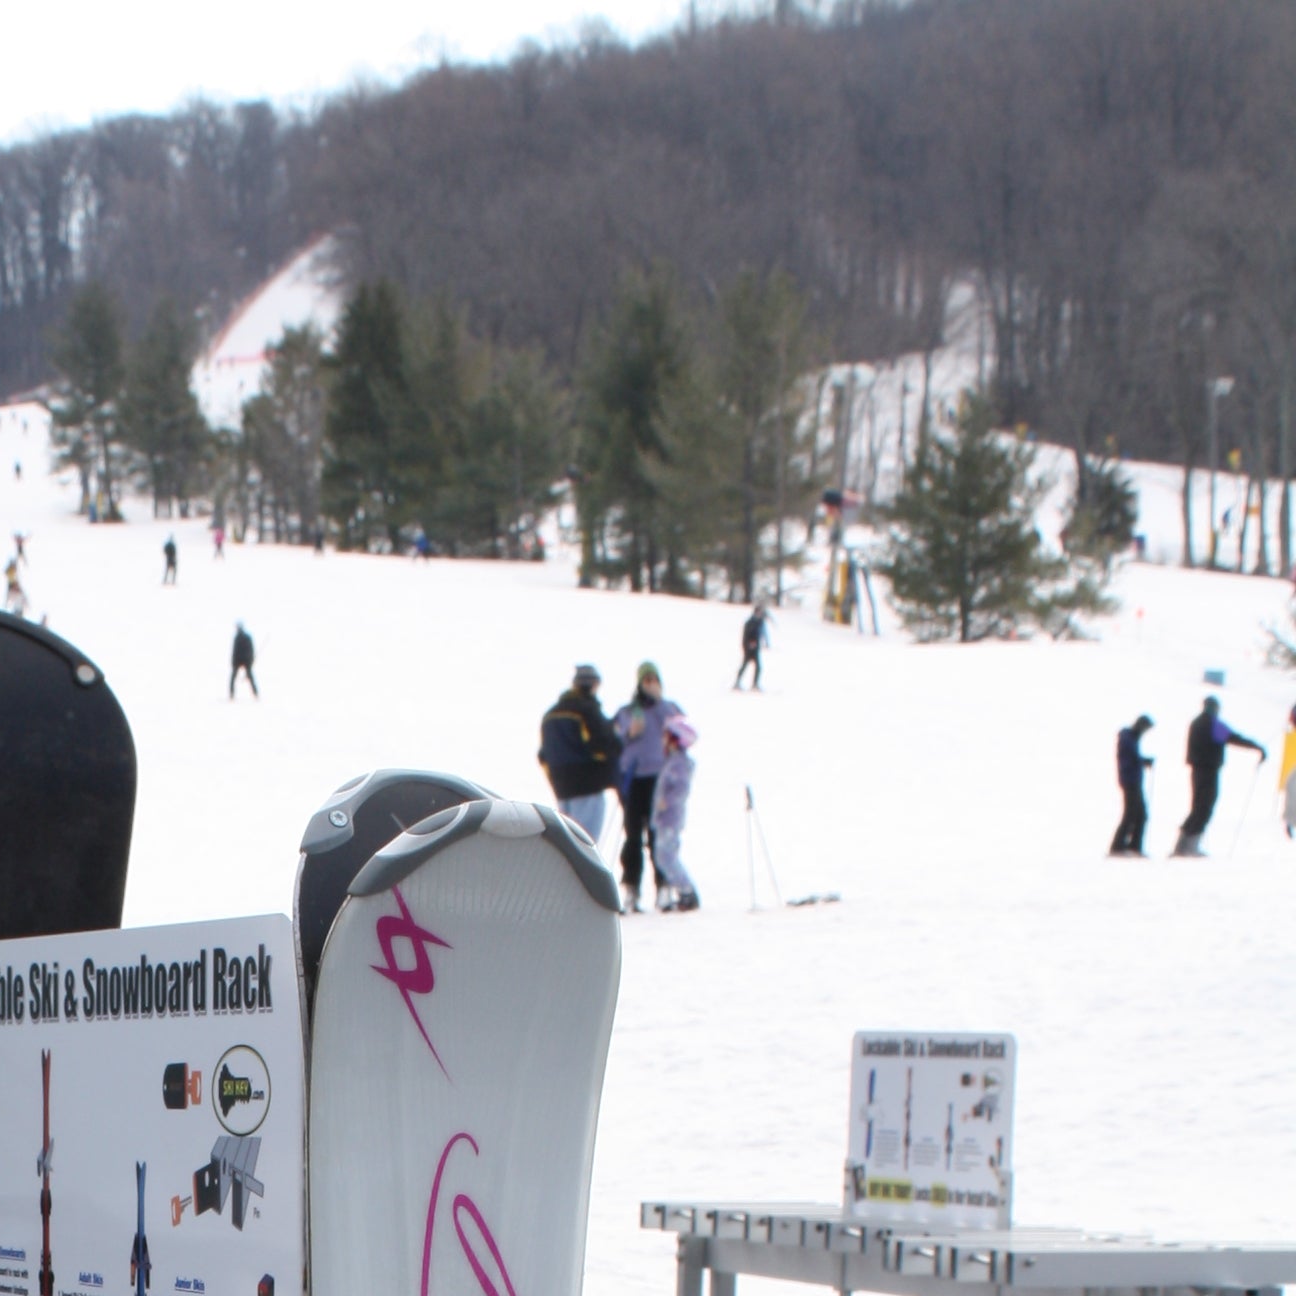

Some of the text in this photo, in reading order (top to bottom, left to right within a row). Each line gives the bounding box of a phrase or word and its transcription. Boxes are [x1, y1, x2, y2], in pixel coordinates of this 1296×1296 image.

[30, 962, 59, 1022] Ski
[64, 969, 77, 1019] &
[83, 949, 206, 1018] Snowboard
[213, 945, 272, 1011] Rack
